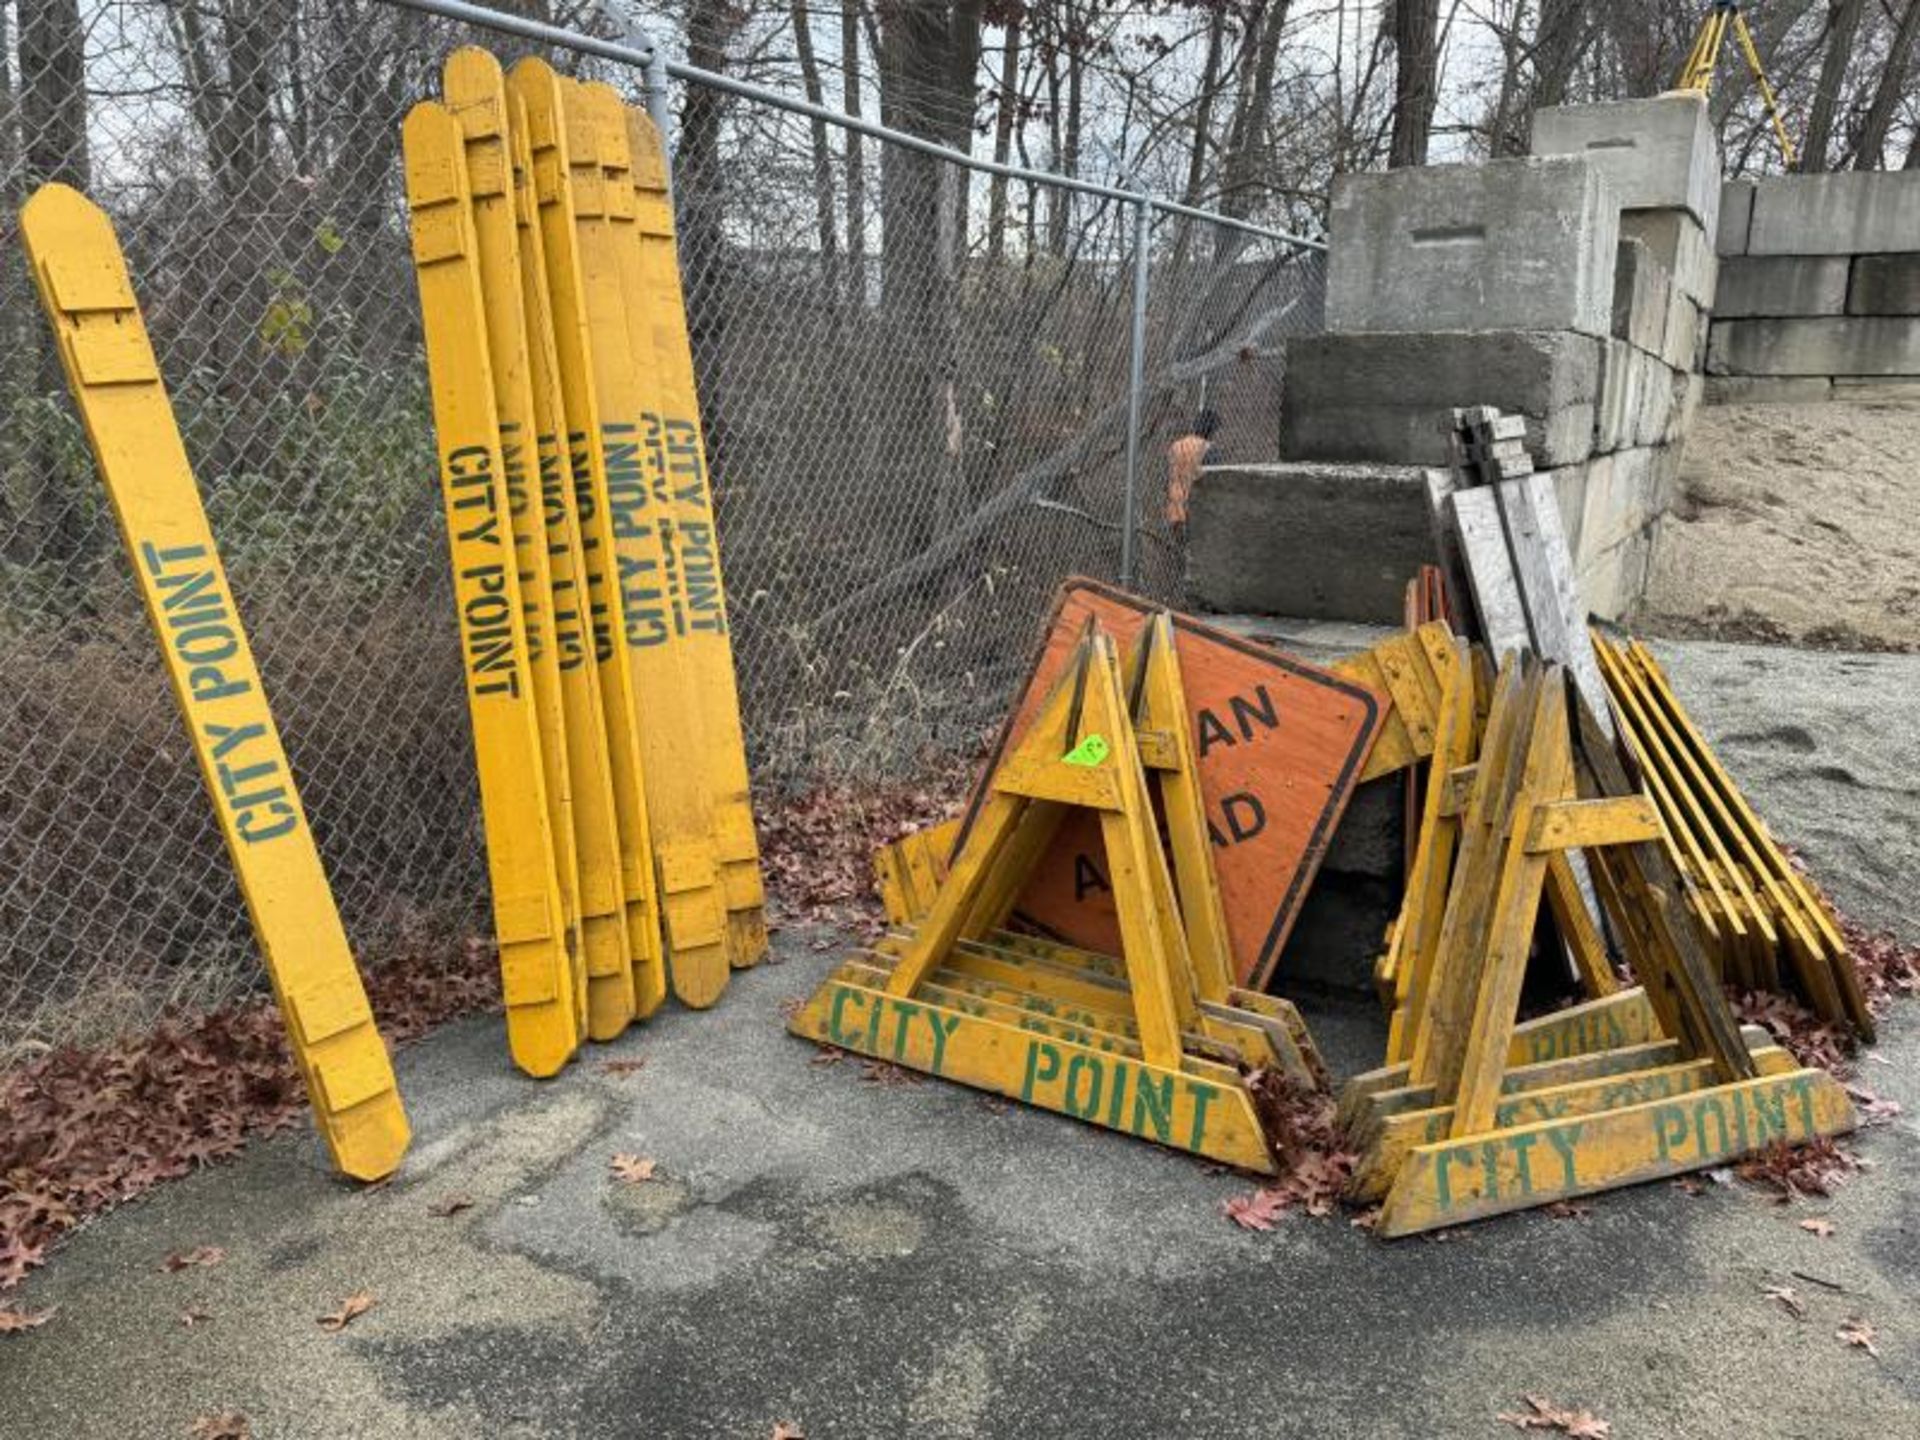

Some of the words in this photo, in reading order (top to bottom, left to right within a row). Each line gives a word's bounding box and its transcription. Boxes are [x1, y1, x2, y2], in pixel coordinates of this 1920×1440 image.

[448, 446, 500, 545] CITY
[602, 423, 652, 538] POINT
[665, 419, 707, 509] CITY
[141, 541, 252, 701] POINT
[461, 564, 519, 699] POINT
[617, 555, 668, 647] CITY
[678, 522, 725, 635] POINT
[204, 723, 297, 843] CITY
[829, 986, 960, 1076] CITY
[1021, 1040, 1220, 1153] POINT
[1436, 1119, 1584, 1212] CITY
[1653, 1077, 1819, 1162] POINT
